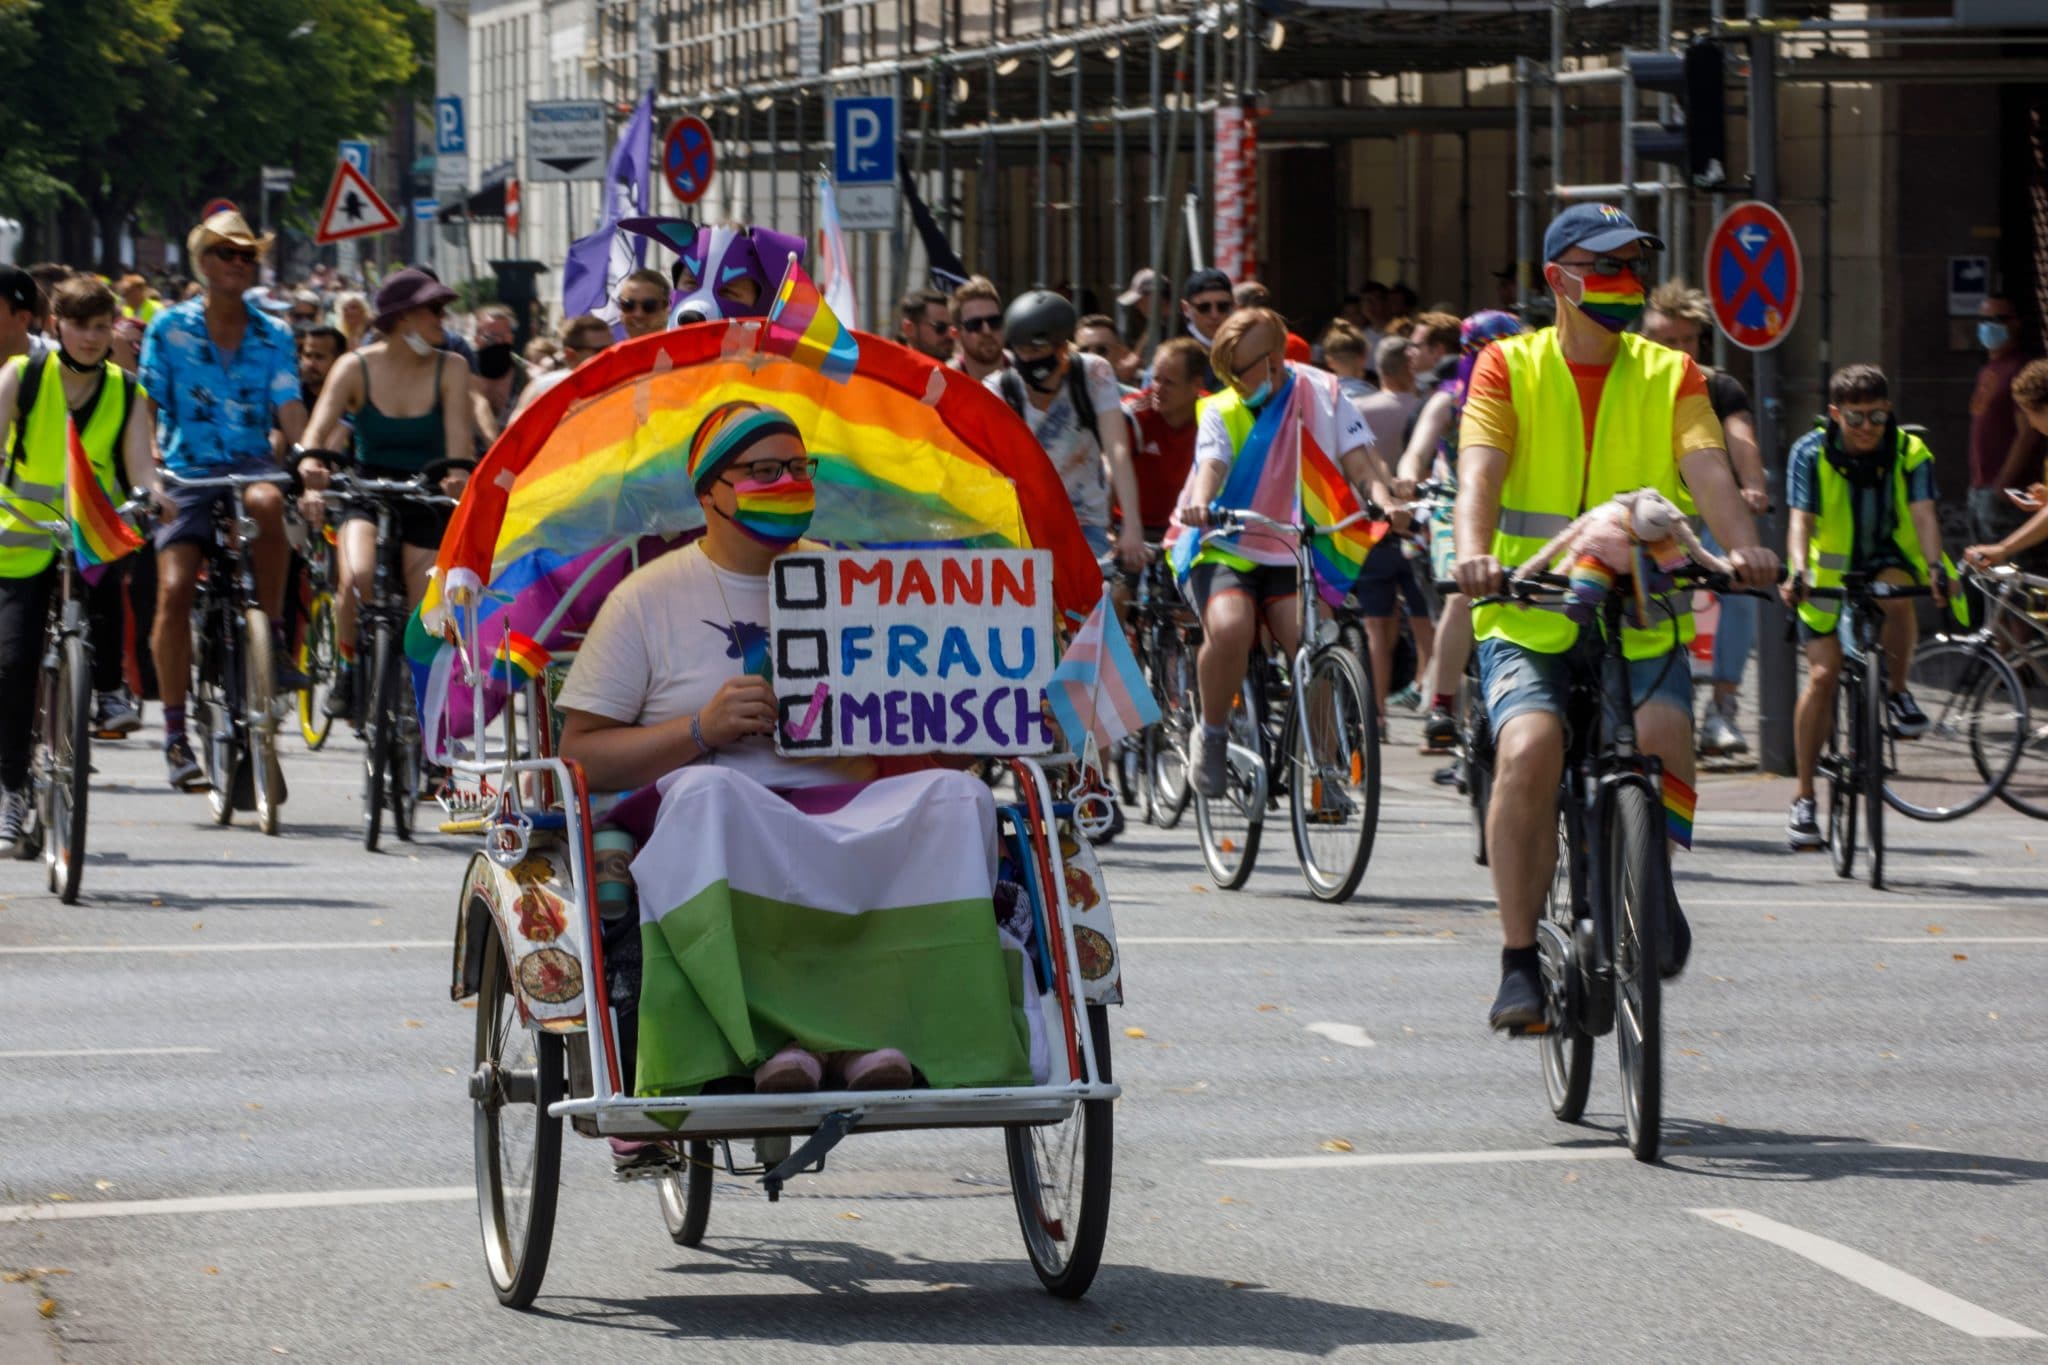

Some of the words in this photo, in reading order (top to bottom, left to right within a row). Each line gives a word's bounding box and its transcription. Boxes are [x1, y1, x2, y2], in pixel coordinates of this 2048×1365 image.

[441, 104, 458, 148] P
[847, 108, 881, 173] P
[839, 557, 1037, 607] MANN
[840, 624, 1036, 680] FRAU
[839, 686, 1054, 746] MENSCH
